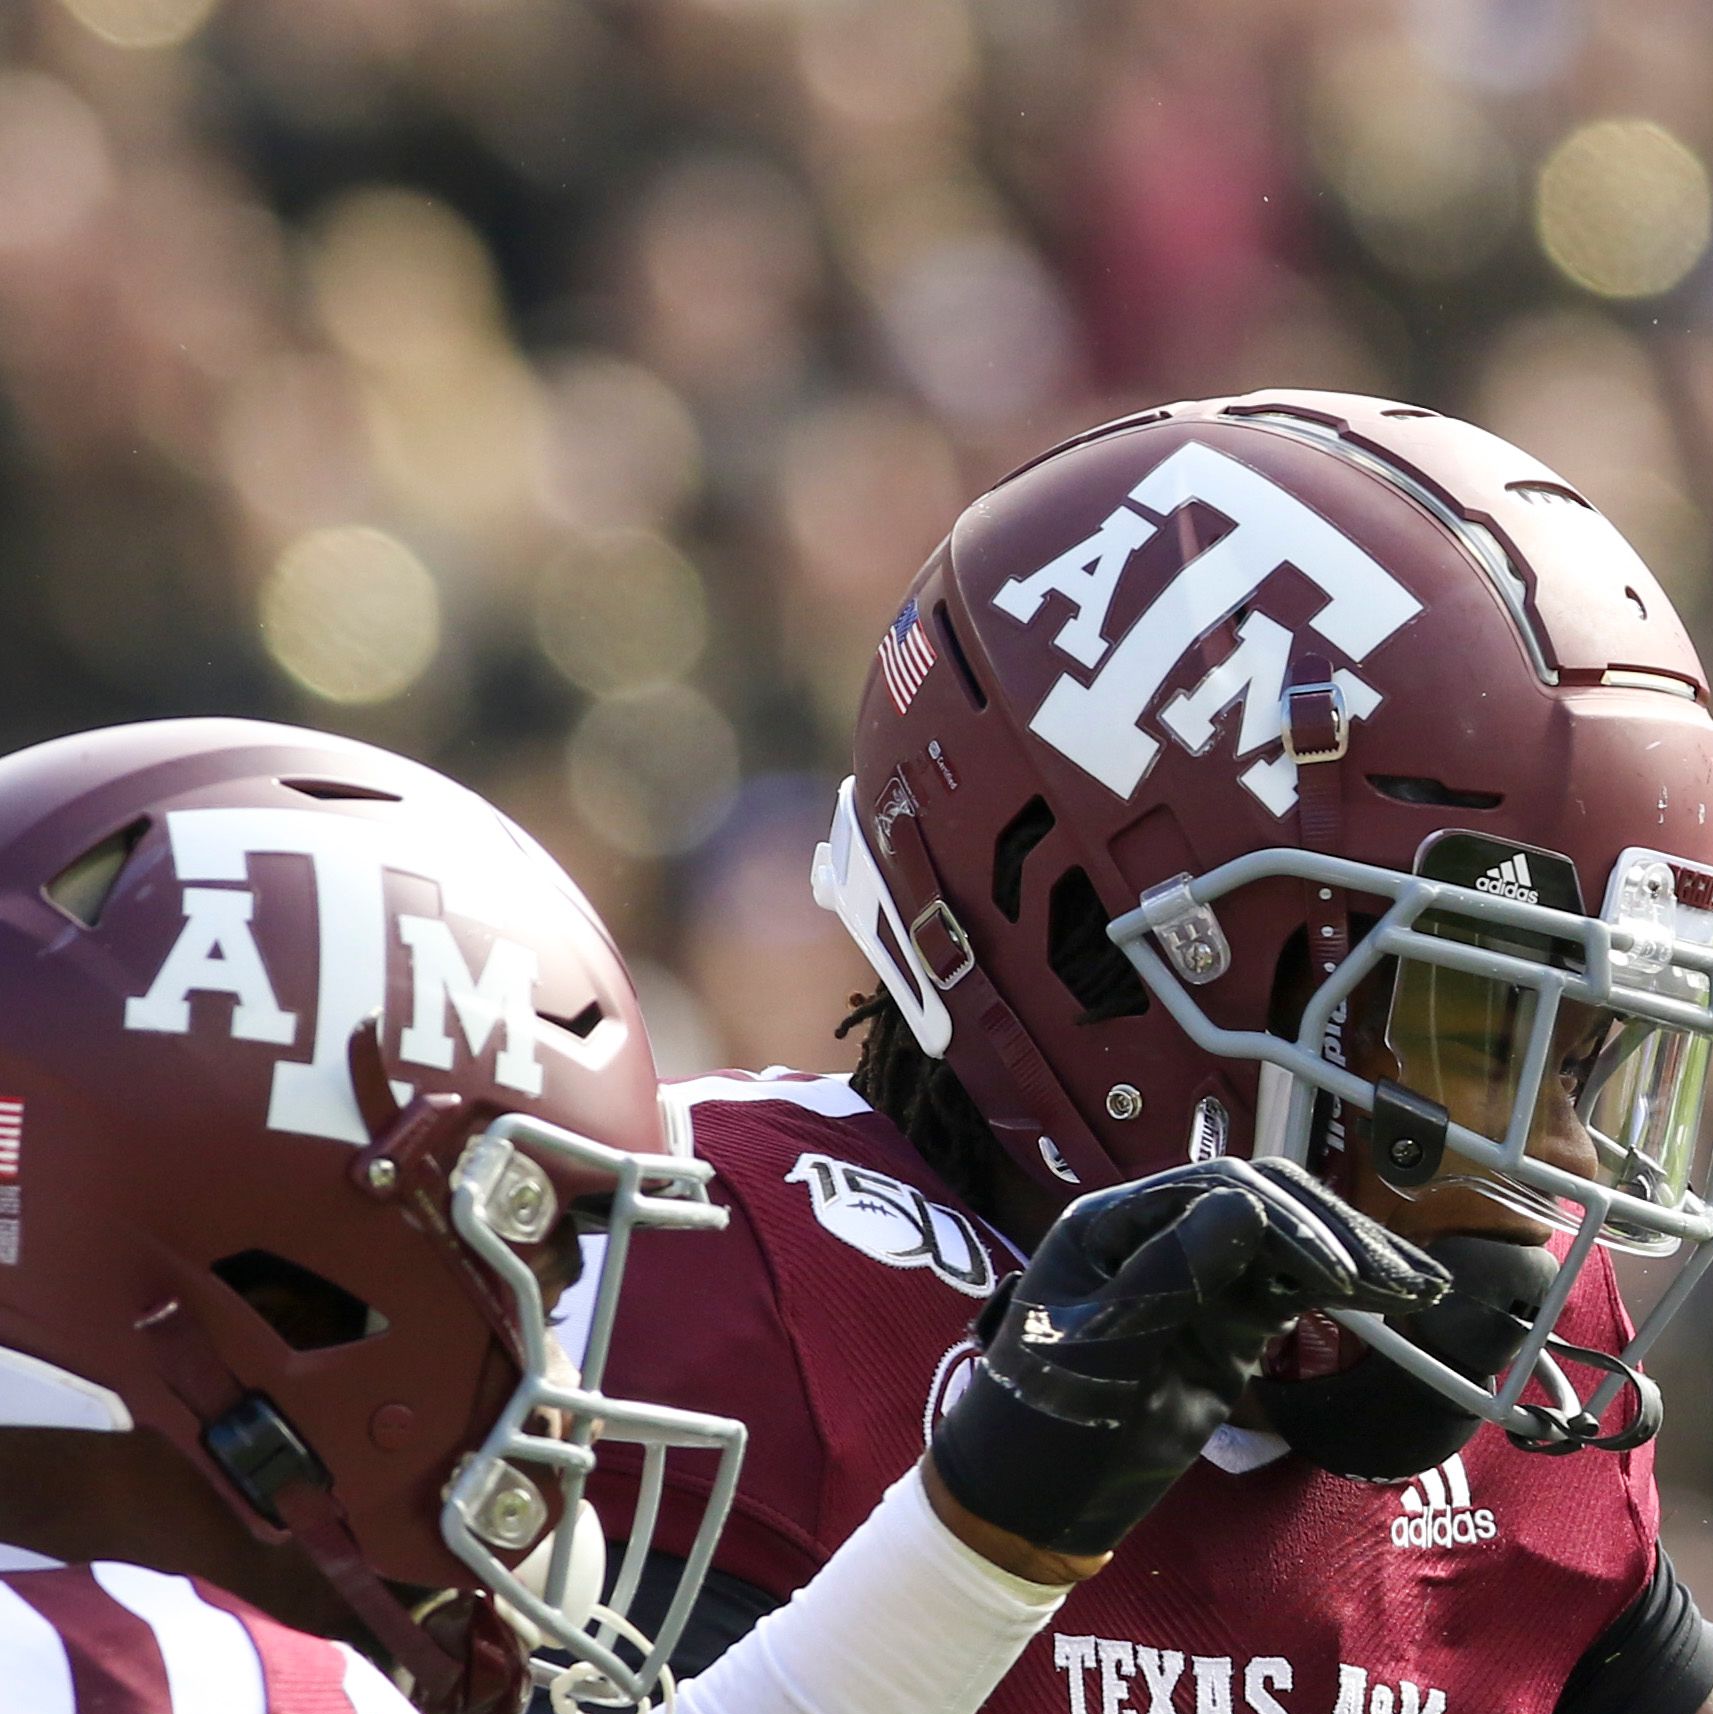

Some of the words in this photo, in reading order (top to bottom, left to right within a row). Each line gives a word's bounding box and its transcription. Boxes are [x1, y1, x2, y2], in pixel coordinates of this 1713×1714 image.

[1475, 874, 1540, 905] adidas
[808, 1159, 988, 1288] 150
[1391, 1504, 1497, 1549] adidas
